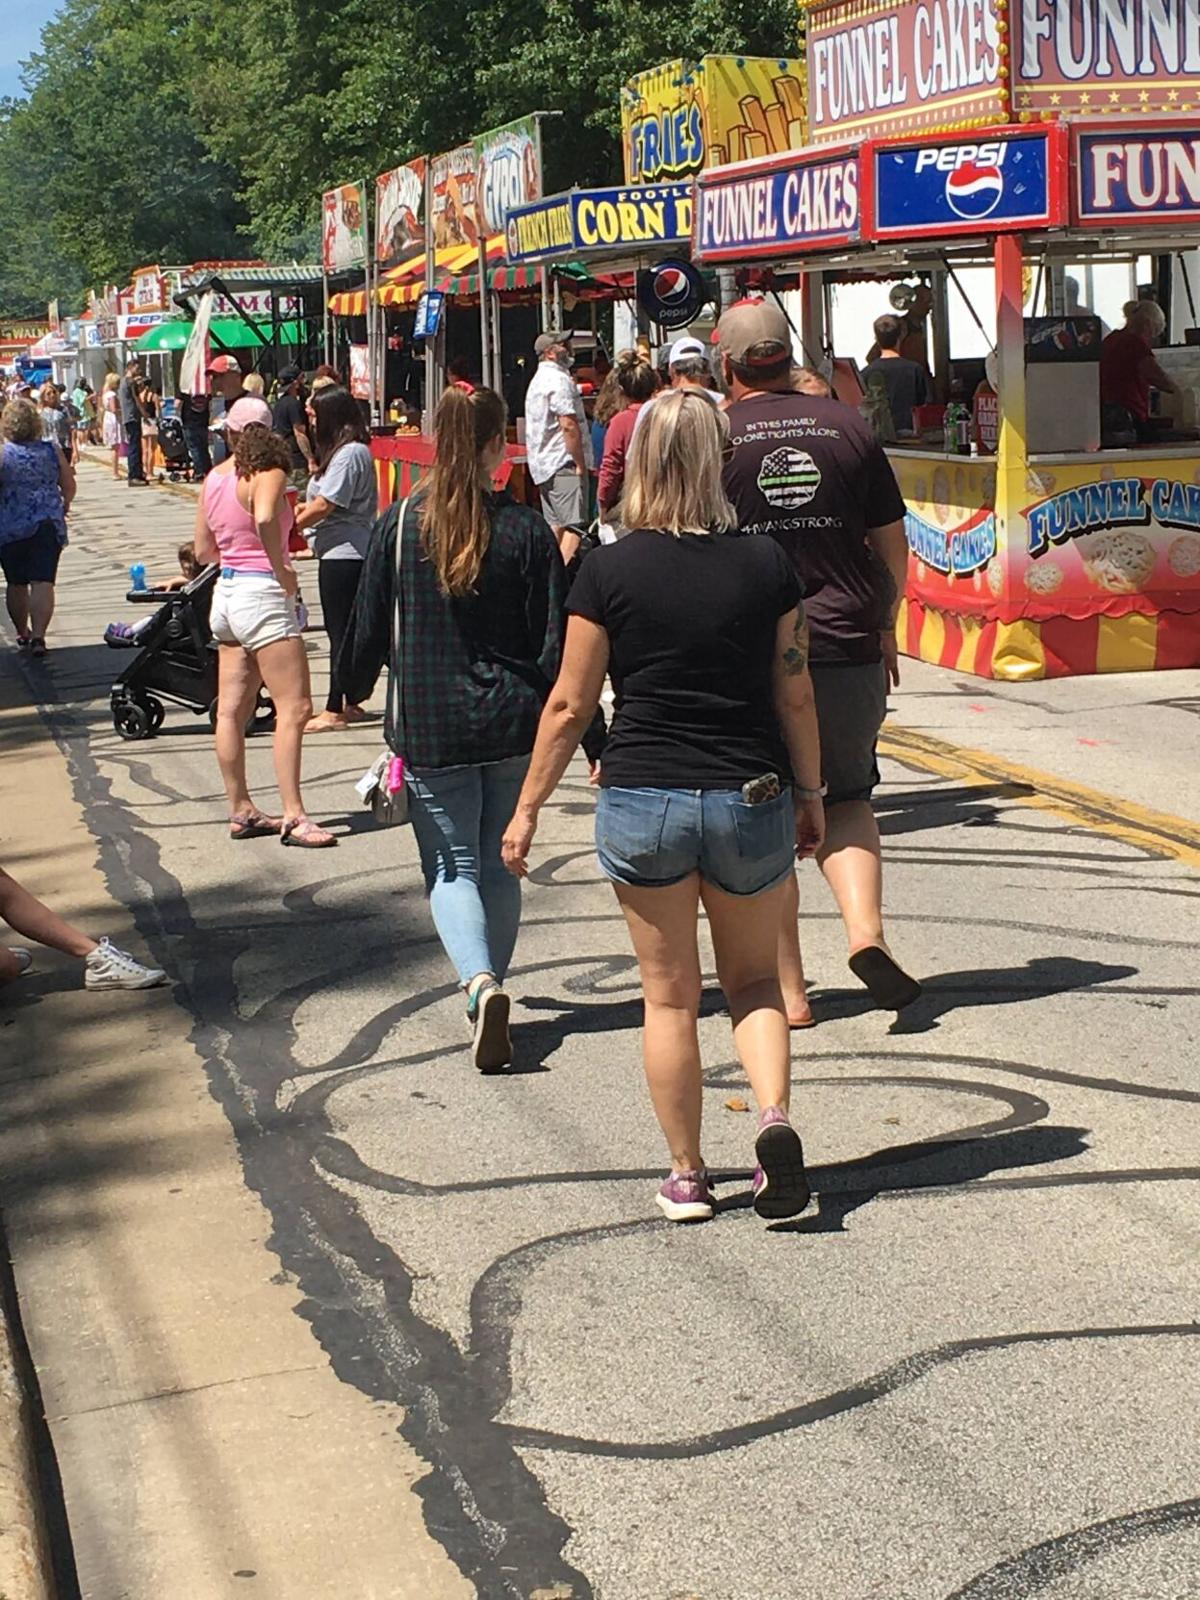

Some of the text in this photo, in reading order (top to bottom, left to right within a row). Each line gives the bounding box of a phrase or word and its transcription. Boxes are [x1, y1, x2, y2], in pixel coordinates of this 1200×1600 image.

[813, 0, 1000, 123] FUNNEL CAKES
[629, 101, 704, 182] FRIES
[915, 142, 1008, 173] PEPSI
[1091, 140, 1200, 207] FUN
[578, 199, 665, 245] CORN
[702, 162, 858, 245] FUNNEL CAKES
[743, 432, 767, 443] ONE
[767, 427, 804, 440] FIGHTS
[804, 427, 840, 439] ALONE
[746, 417, 817, 432] IN THIS FAMILY
[951, 511, 996, 573] CAKES
[1028, 478, 1149, 554] FUNNEL
